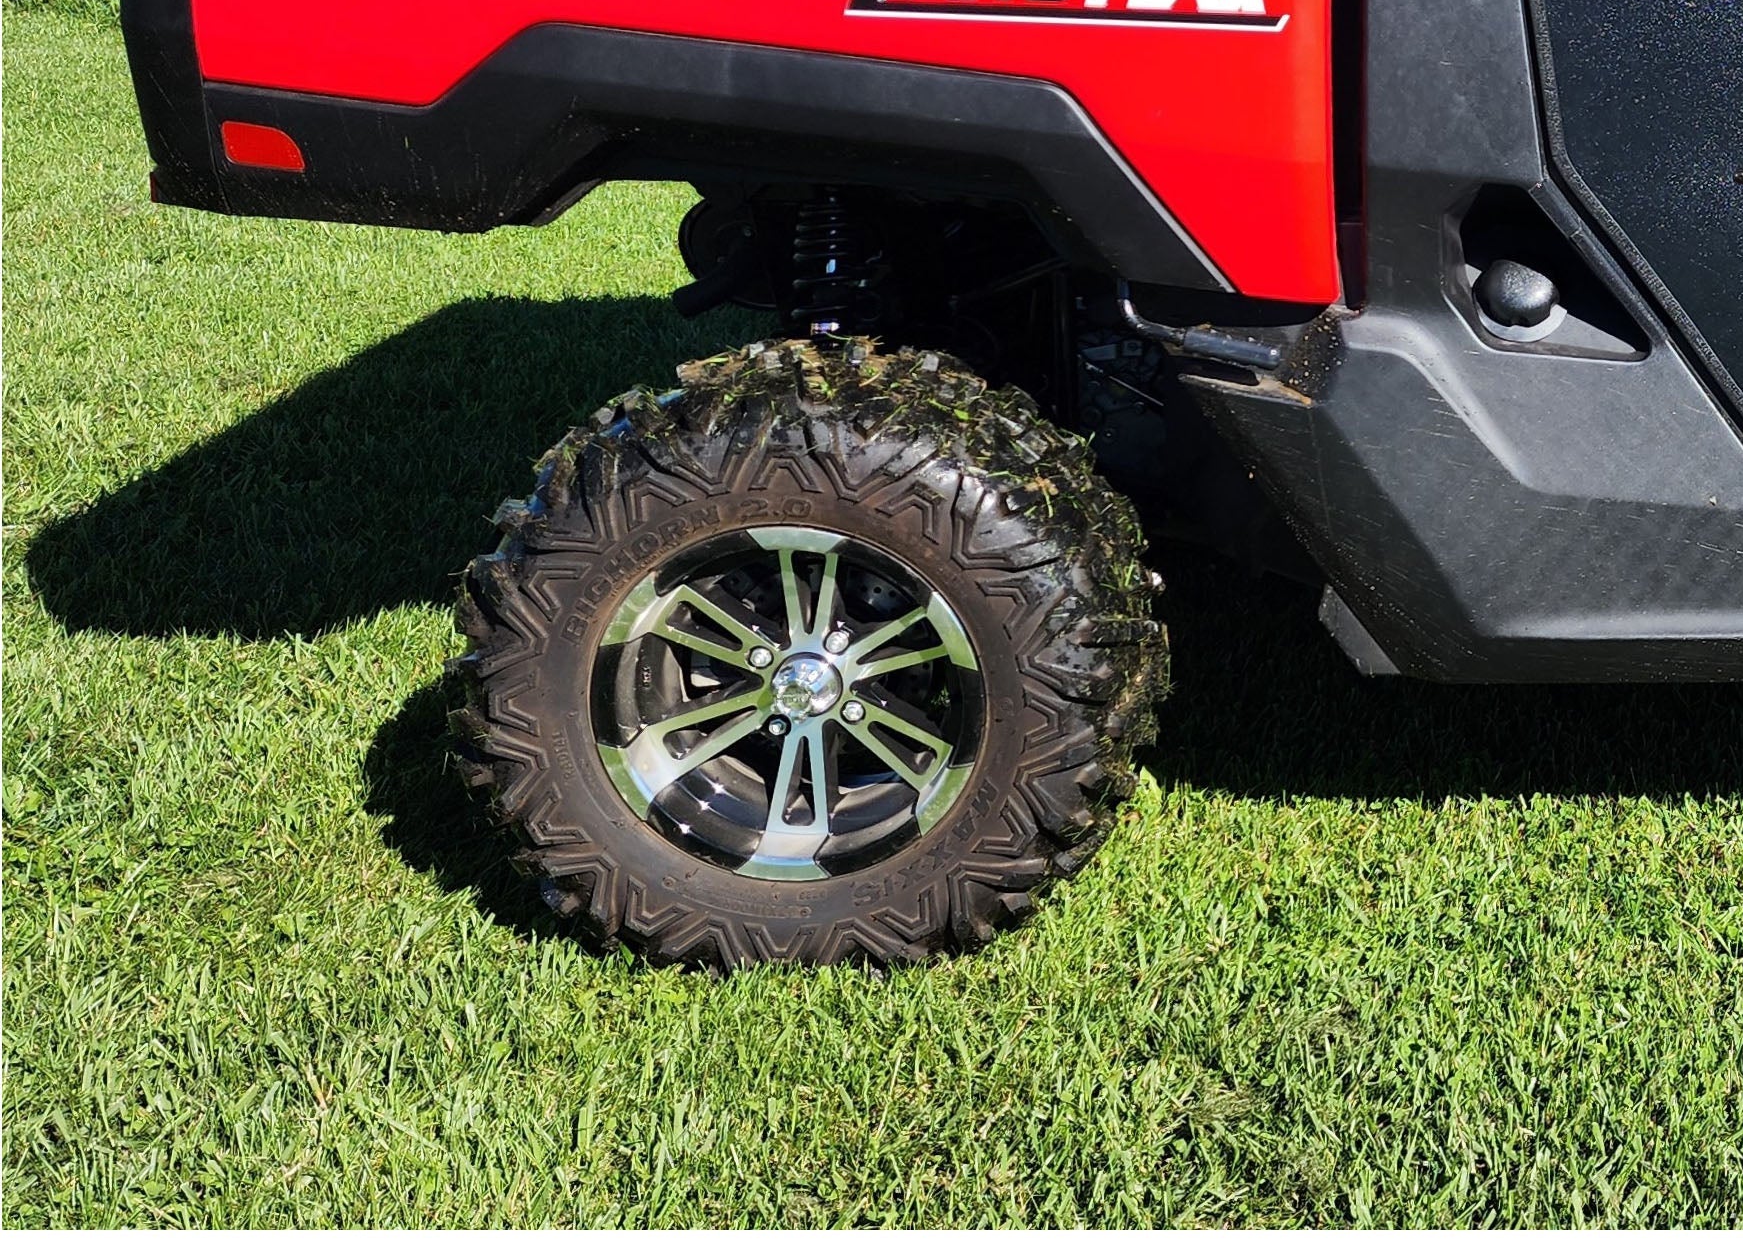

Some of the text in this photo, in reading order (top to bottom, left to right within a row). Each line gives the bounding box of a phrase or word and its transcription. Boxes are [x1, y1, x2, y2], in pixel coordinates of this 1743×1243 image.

[560, 505, 721, 642] BIGHORN
[740, 498, 813, 518] 2.0
[854, 777, 999, 906] MAXXIS
